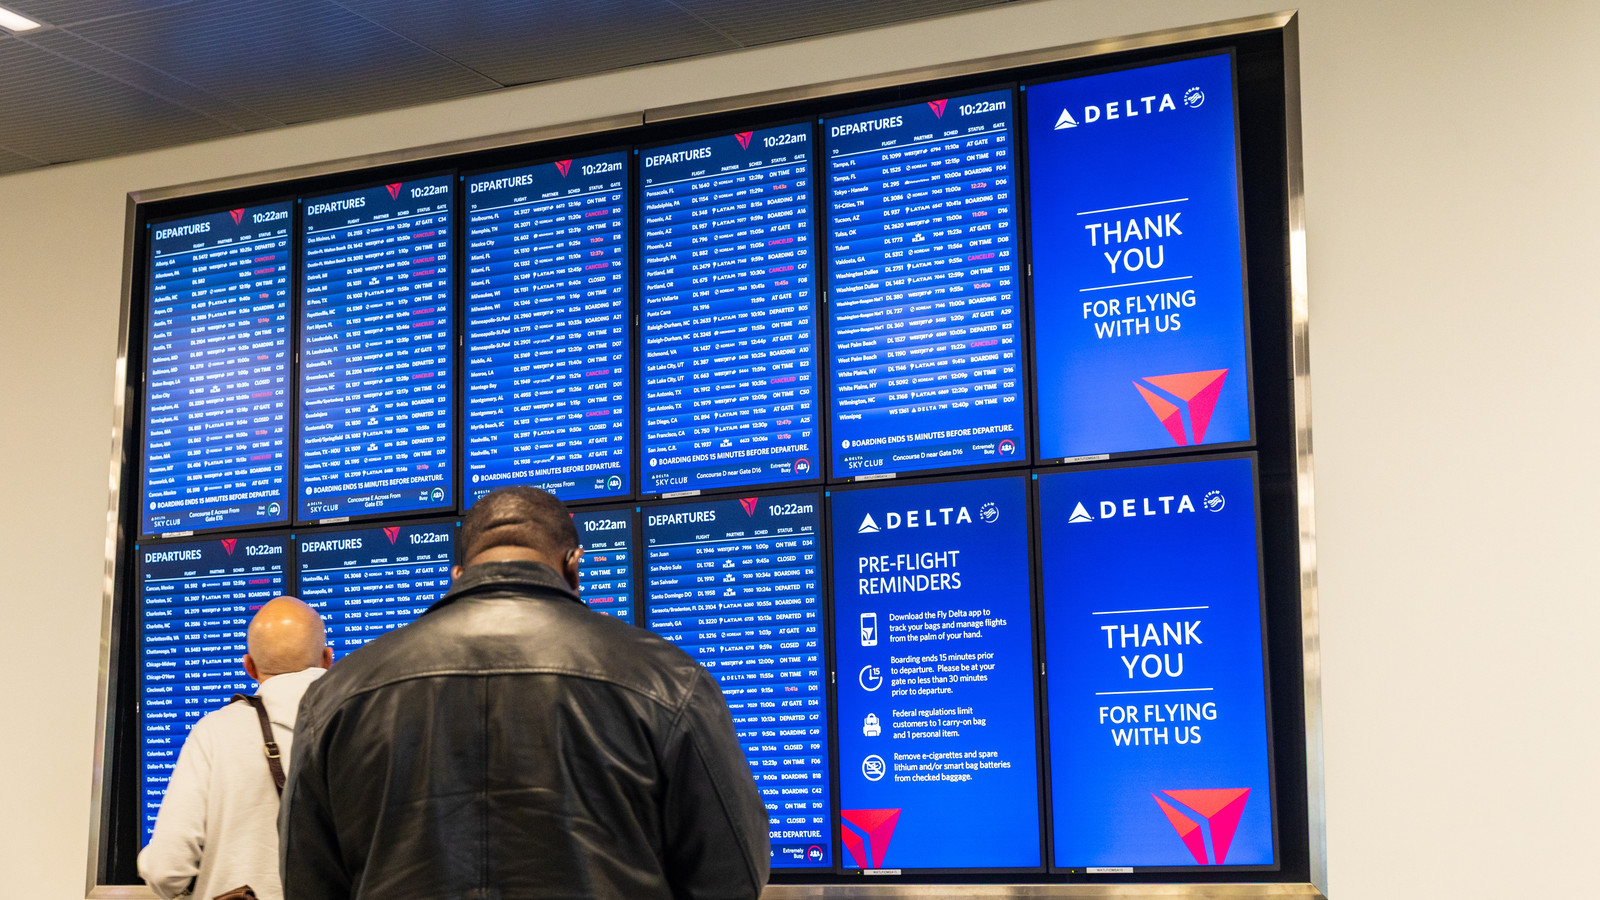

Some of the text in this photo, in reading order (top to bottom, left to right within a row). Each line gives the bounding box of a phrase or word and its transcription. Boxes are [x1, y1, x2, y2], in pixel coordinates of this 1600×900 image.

[959, 101, 1006, 116] 10:22am
[1085, 93, 1176, 123] DELTA
[832, 116, 903, 137] DEPARTURES
[764, 133, 806, 148] 10:22am
[646, 147, 712, 167] DEPARTURES
[582, 162, 622, 175] 10:22am
[964, 166, 992, 176] BOARDING
[471, 174, 533, 193] DEPARTURES
[411, 185, 448, 198] 10:22am
[308, 197, 365, 215] DEPARTURES
[253, 211, 288, 223] 10:22am
[156, 222, 210, 240] DEPARTURES
[1085, 212, 1183, 246] THANK
[768, 237, 794, 246] CANCELED
[967, 252, 995, 261] CANCELED
[1104, 245, 1164, 274] YOU
[1083, 290, 1196, 319] FOR FLYING
[1094, 314, 1181, 339] WITH US
[852, 437, 887, 447] BOARDING
[888, 435, 906, 444] ENDS
[914, 431, 945, 441] MINUTES
[946, 428, 971, 438] BEFORE
[972, 424, 1014, 435] DEPARTURE.
[659, 455, 691, 465] BOARDING
[692, 454, 709, 462] ENDS
[717, 450, 745, 459] MINUTES
[746, 447, 770, 456] BEFORE
[770, 444, 809, 454] DEPARTURE.
[848, 459, 883, 469] SKY CLUB
[481, 472, 511, 482] BOARDING
[512, 470, 528, 478] ENDS
[535, 467, 562, 476] MINUTES
[562, 464, 584, 473] BEFORE
[585, 461, 621, 471] DEPARTURE.
[769, 503, 813, 516] 10:22am
[1100, 495, 1195, 519] DELTA
[166, 518, 180, 526] CLUB
[584, 519, 626, 531] 10:22am
[648, 510, 716, 526] DEPARTURES
[887, 507, 972, 529] DELTA
[302, 538, 362, 552] DEPARTURES
[410, 532, 449, 544] 10:22am
[145, 549, 202, 563] DEPARTURES
[246, 545, 282, 556] 10:22am
[859, 550, 960, 574] PRE-FLIGHT
[859, 572, 961, 595] REMINDERS
[889, 612, 924, 621] Download
[924, 611, 936, 619] the
[937, 610, 947, 620] Fly
[948, 609, 967, 618] Delta
[889, 618, 1007, 632] track your bags and manage flights
[890, 634, 906, 642] from
[920, 632, 937, 642] palm
[938, 632, 946, 640] of
[946, 633, 962, 641] your
[963, 630, 983, 638] hand.
[1101, 620, 1203, 649] THANK
[890, 651, 994, 664] Boarding ends 15 minutes prior
[899, 666, 934, 675] departure.
[937, 664, 960, 672] Please
[960, 663, 970, 671] be
[979, 664, 995, 672] your
[1121, 653, 1183, 679] YOU
[891, 678, 906, 687] gate
[917, 676, 931, 684] less
[932, 675, 948, 683] than
[948, 674, 958, 683] 30
[960, 674, 988, 682] minutes
[892, 688, 908, 697] prior
[918, 687, 953, 696] departure.
[892, 707, 973, 718] Federal regulations limit
[1099, 702, 1217, 724] FOR FLYING
[942, 719, 972, 727] carry-on
[973, 717, 986, 726] bag
[893, 731, 906, 739] and
[911, 729, 941, 740] personal
[1111, 726, 1201, 746] WITH US
[894, 752, 921, 761] Remove
[922, 751, 963, 761] e-cigarettes
[964, 750, 977, 758] and
[894, 763, 918, 771] lithium
[919, 762, 943, 771] and/or
[965, 761, 979, 771] bag
[979, 760, 1011, 769] batteries
[912, 773, 940, 782] checked
[941, 773, 972, 782] baggage.
